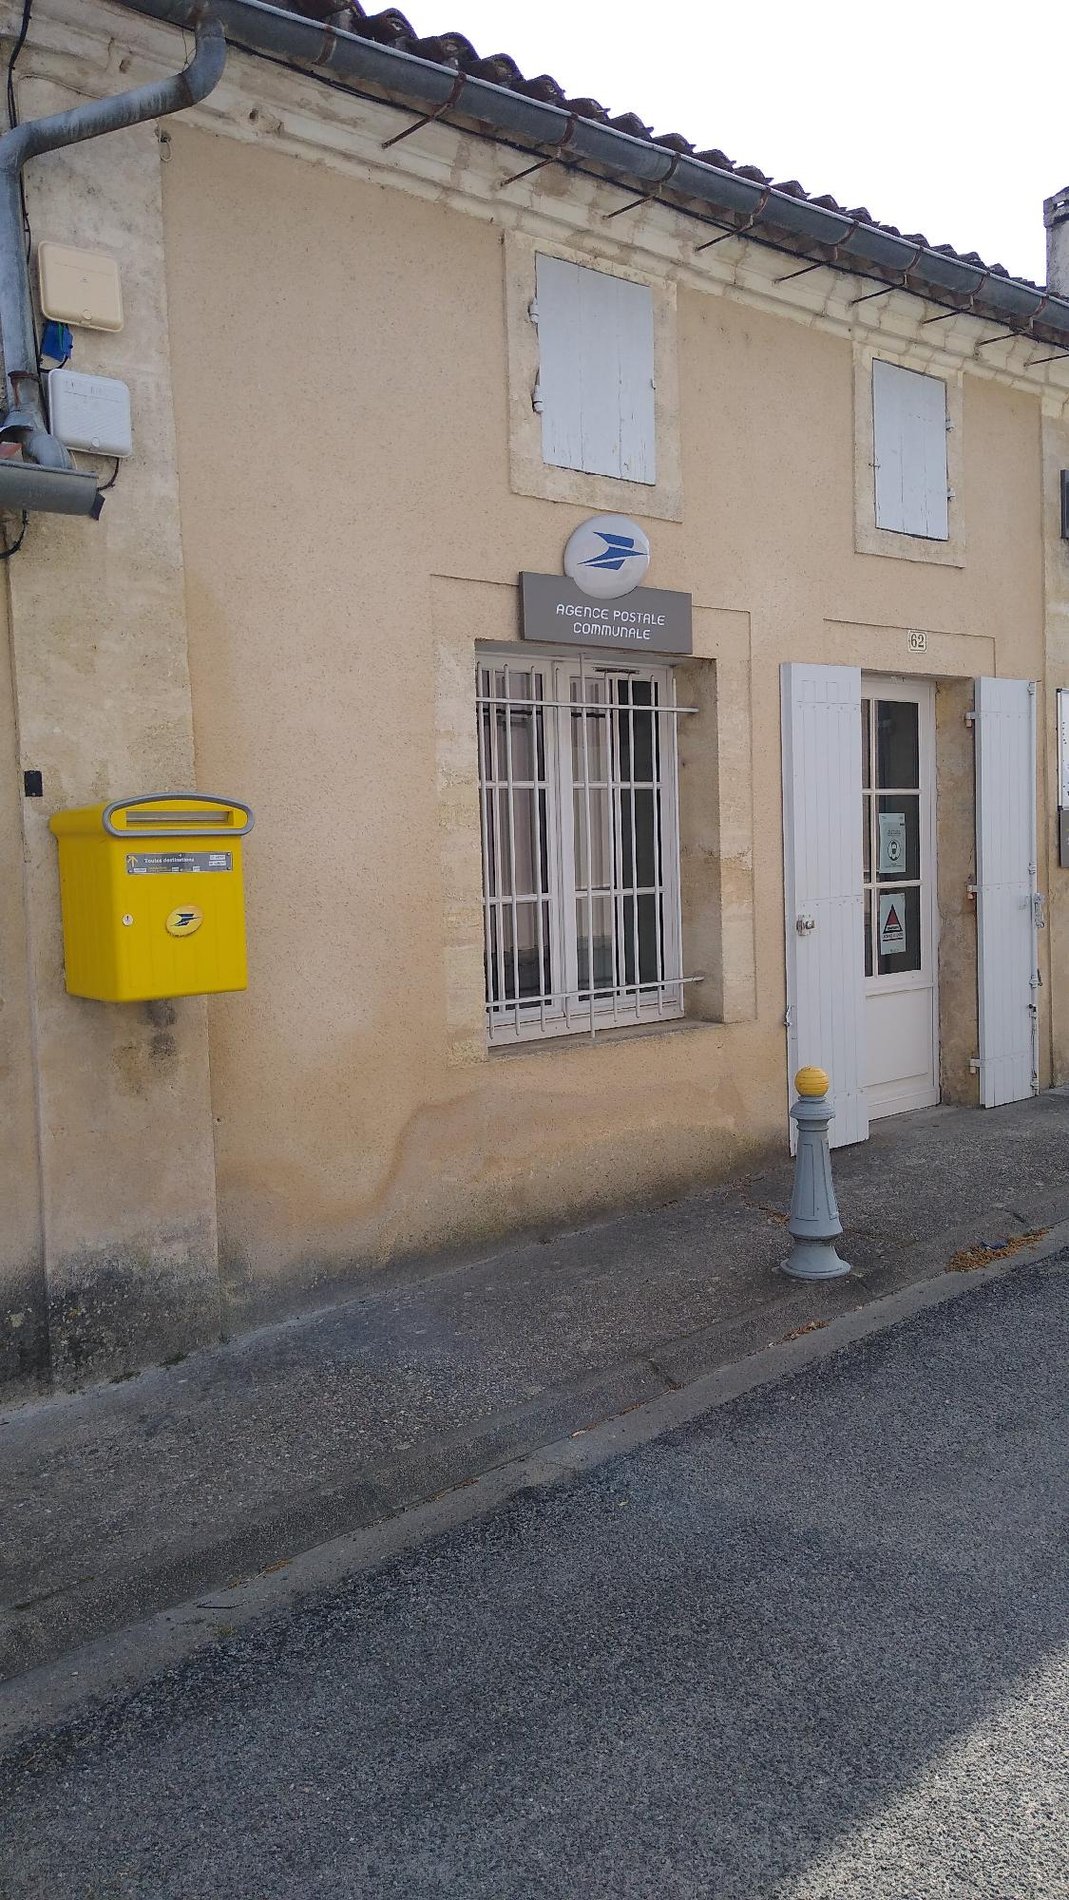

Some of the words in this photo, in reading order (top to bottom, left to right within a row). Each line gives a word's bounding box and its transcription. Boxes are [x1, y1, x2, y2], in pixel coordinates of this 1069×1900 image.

[556, 603, 609, 620] AGENCE
[614, 610, 666, 626] POSTALE
[573, 622, 651, 640] COMMUNALE
[911, 634, 924, 648] 62
